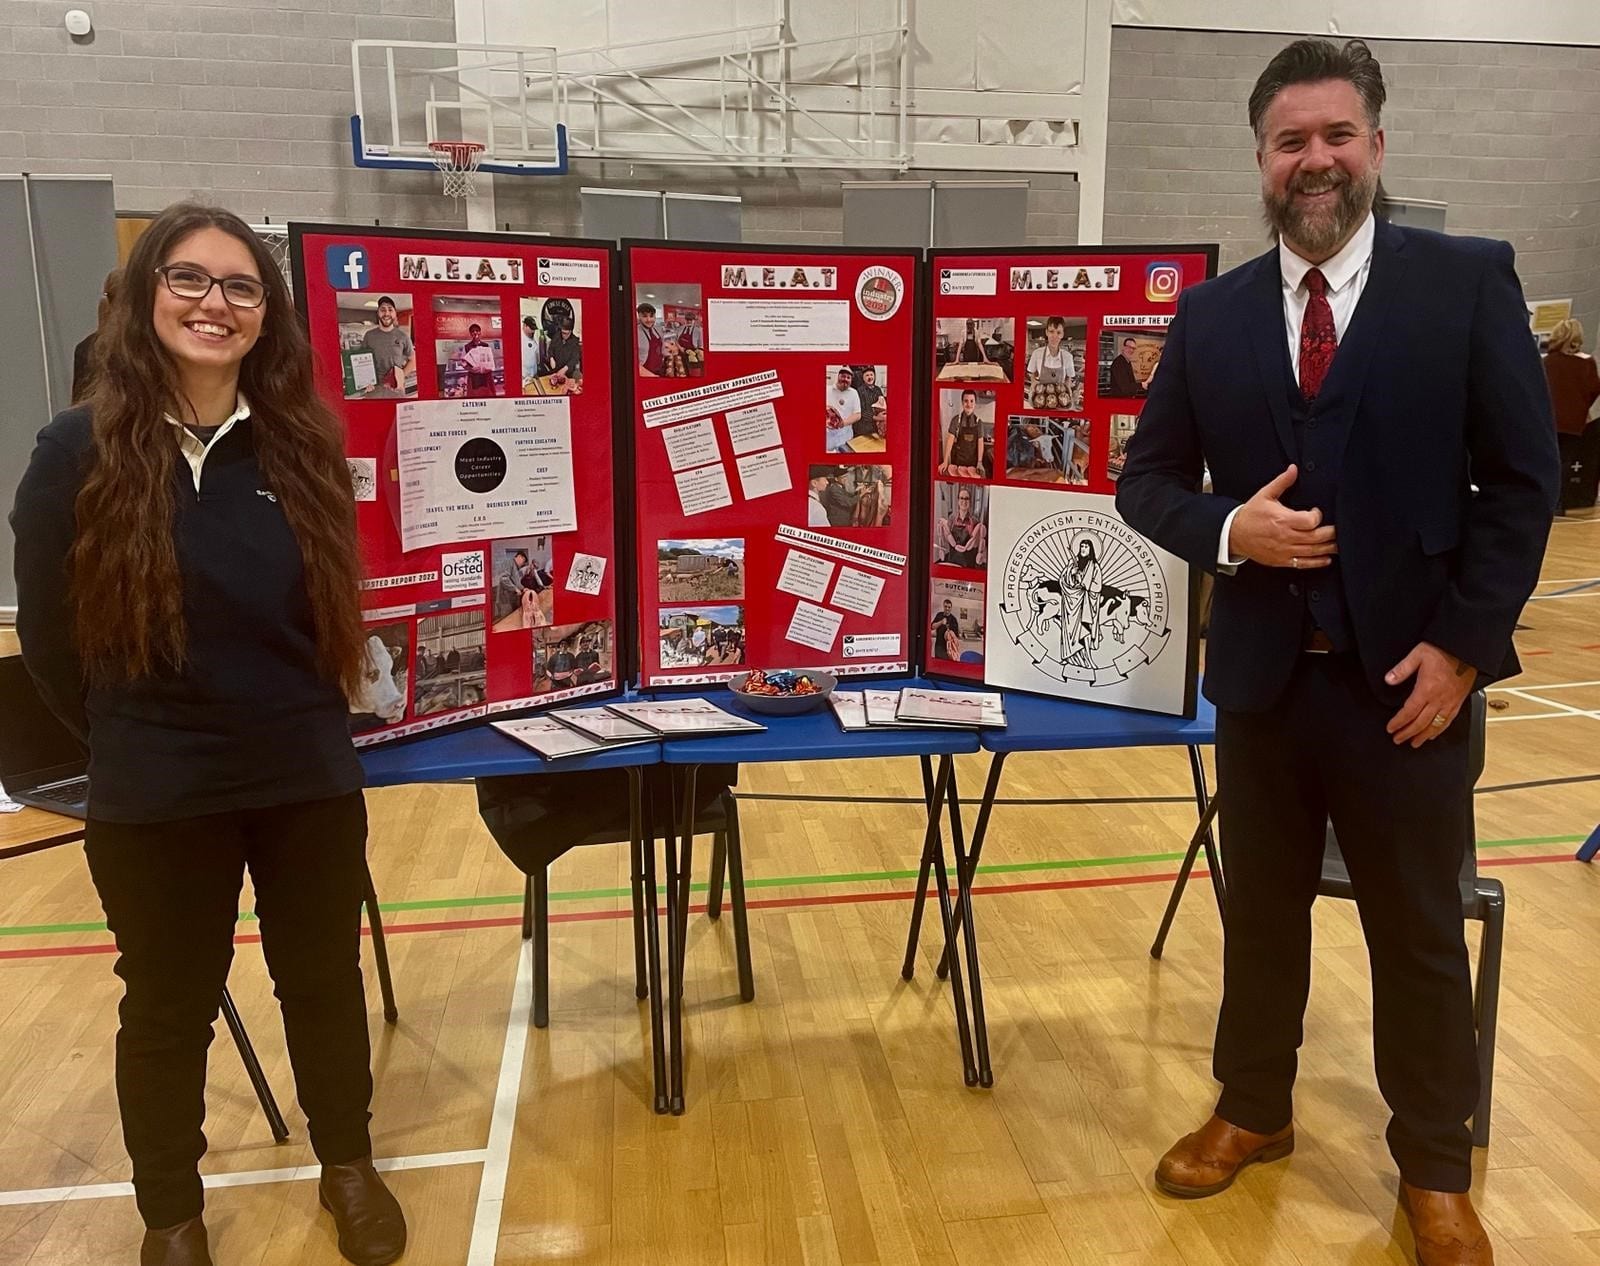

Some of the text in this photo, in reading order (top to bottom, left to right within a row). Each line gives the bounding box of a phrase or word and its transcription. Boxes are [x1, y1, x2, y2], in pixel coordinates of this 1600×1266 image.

[402, 256, 522, 281] M.E.A.T
[723, 267, 836, 288] M.E.A.T
[863, 267, 902, 290] WINNER
[1011, 267, 1118, 290] M.E.A.T
[865, 300, 888, 311] 2021
[1105, 317, 1135, 325] LEARNER
[1137, 317, 1146, 325] OF
[1149, 317, 1160, 325] THE
[644, 400, 663, 408] LEVEL
[669, 389, 702, 403] STANDARDS
[702, 383, 730, 395] BUTCHERY
[731, 371, 775, 388] APPRENTICESHIP
[486, 499, 528, 508] BUSINESS OWNER
[779, 526, 796, 536] LEVEL
[803, 531, 834, 545] STANDARDS
[835, 540, 862, 552] BUTCHERY
[862, 547, 905, 563] APPRENTICESHIP
[390, 575, 417, 585] REPORT
[418, 573, 435, 581] 2022
[443, 560, 483, 577] Ofsted
[1007, 515, 1164, 622] PROFESSIONALISM ENTHUSIASM PRIDE
